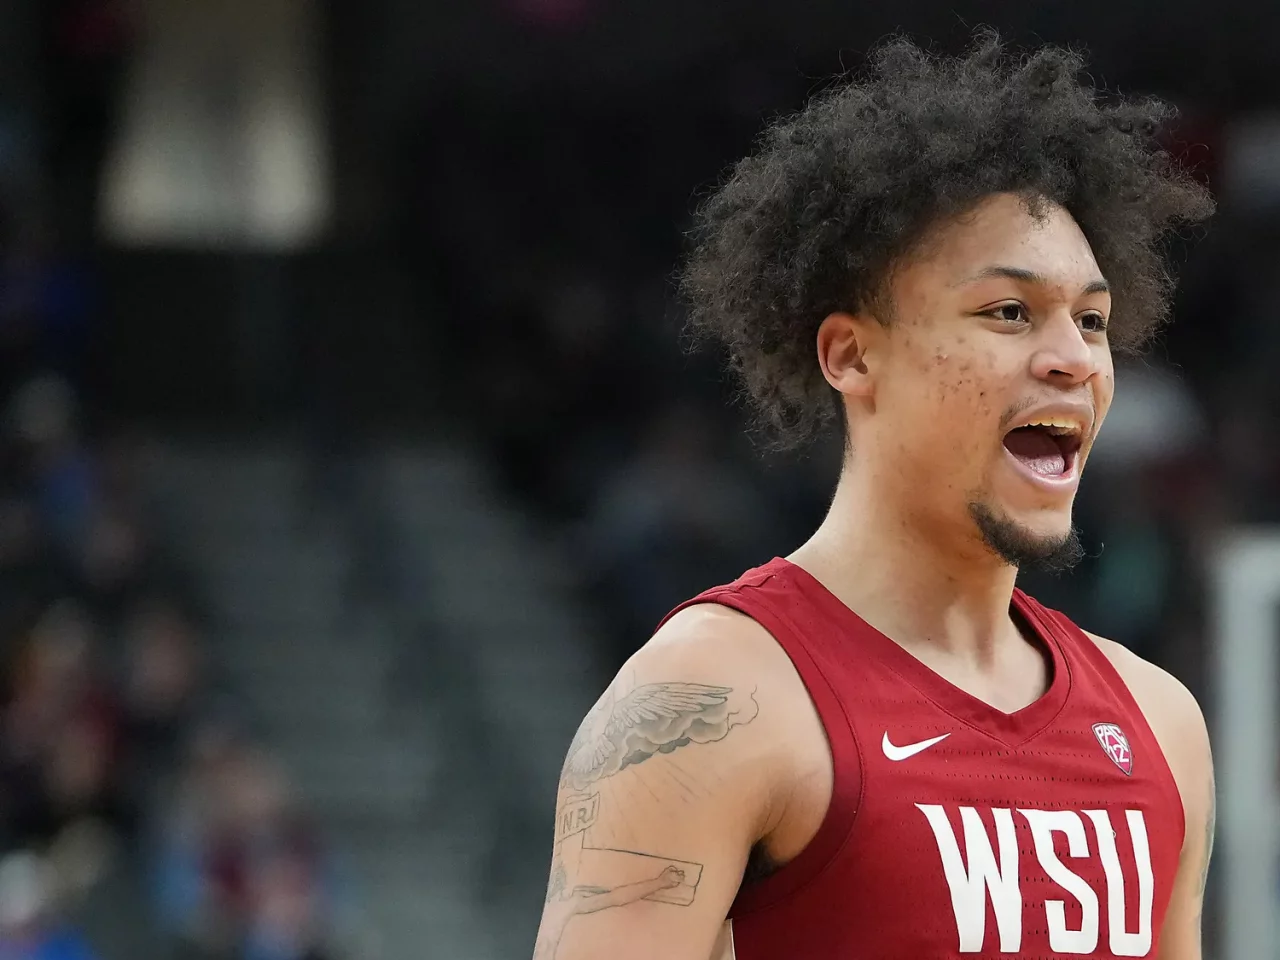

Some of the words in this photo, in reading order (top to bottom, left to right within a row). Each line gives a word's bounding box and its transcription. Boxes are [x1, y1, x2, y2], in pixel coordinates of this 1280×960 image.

[1095, 725, 1129, 754] PAC
[1108, 744, 1130, 763] 12
[914, 803, 1154, 957] WSU
